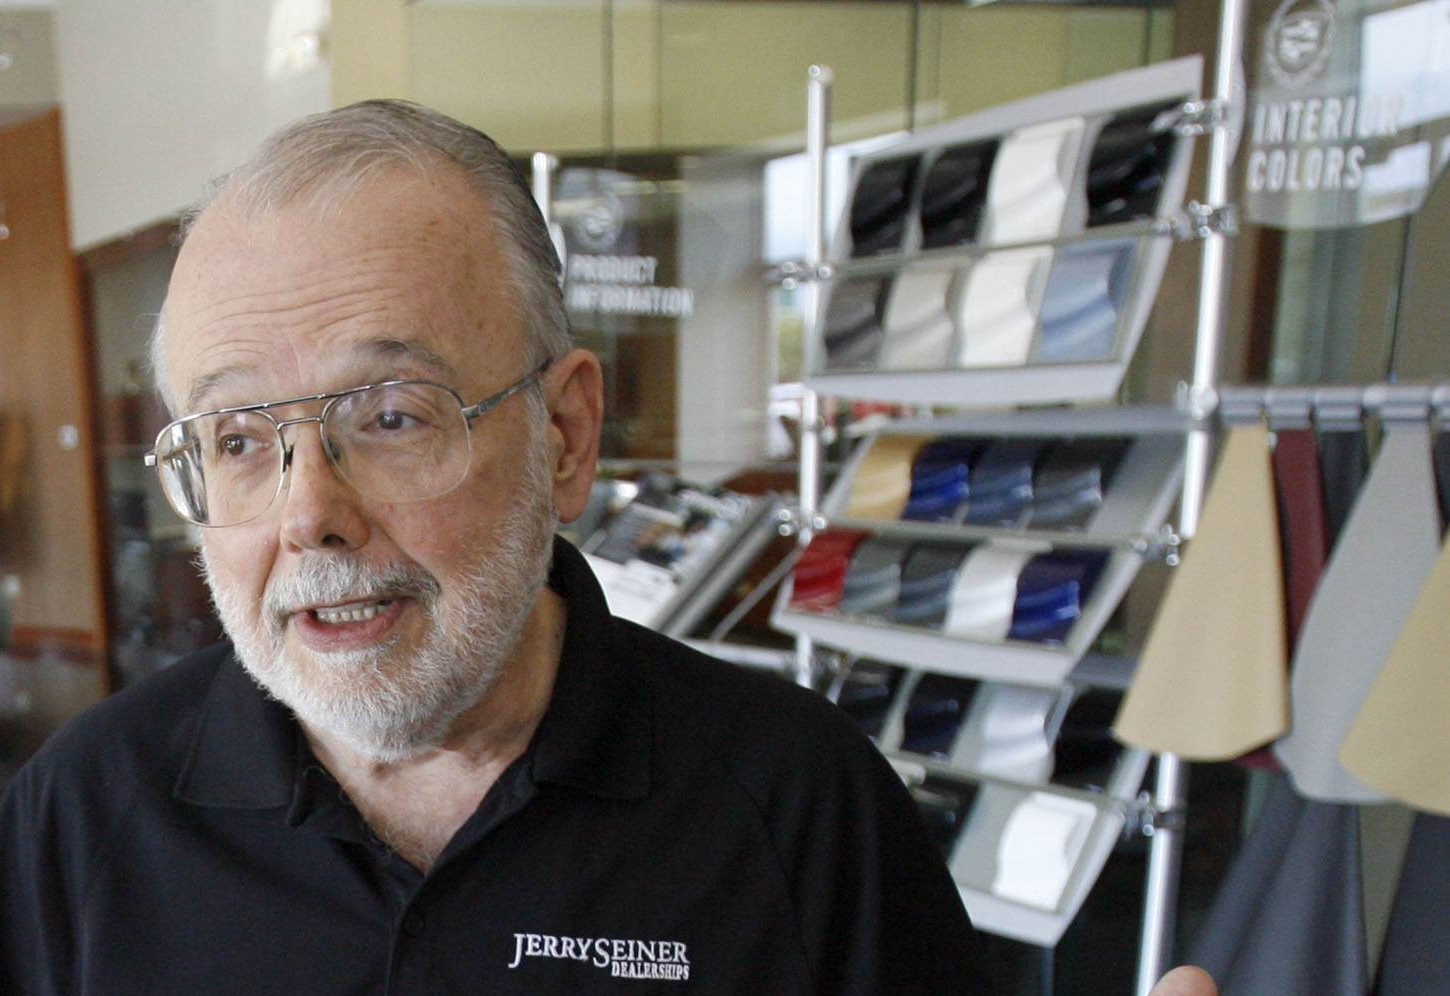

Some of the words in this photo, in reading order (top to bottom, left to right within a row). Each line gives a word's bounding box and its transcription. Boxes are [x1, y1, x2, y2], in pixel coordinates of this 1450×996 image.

[1247, 145, 1365, 191] COLORS
[569, 254, 658, 284] PRODUCT
[569, 284, 694, 317] INFORMATION
[611, 961, 690, 981] DEALERSHIPS
